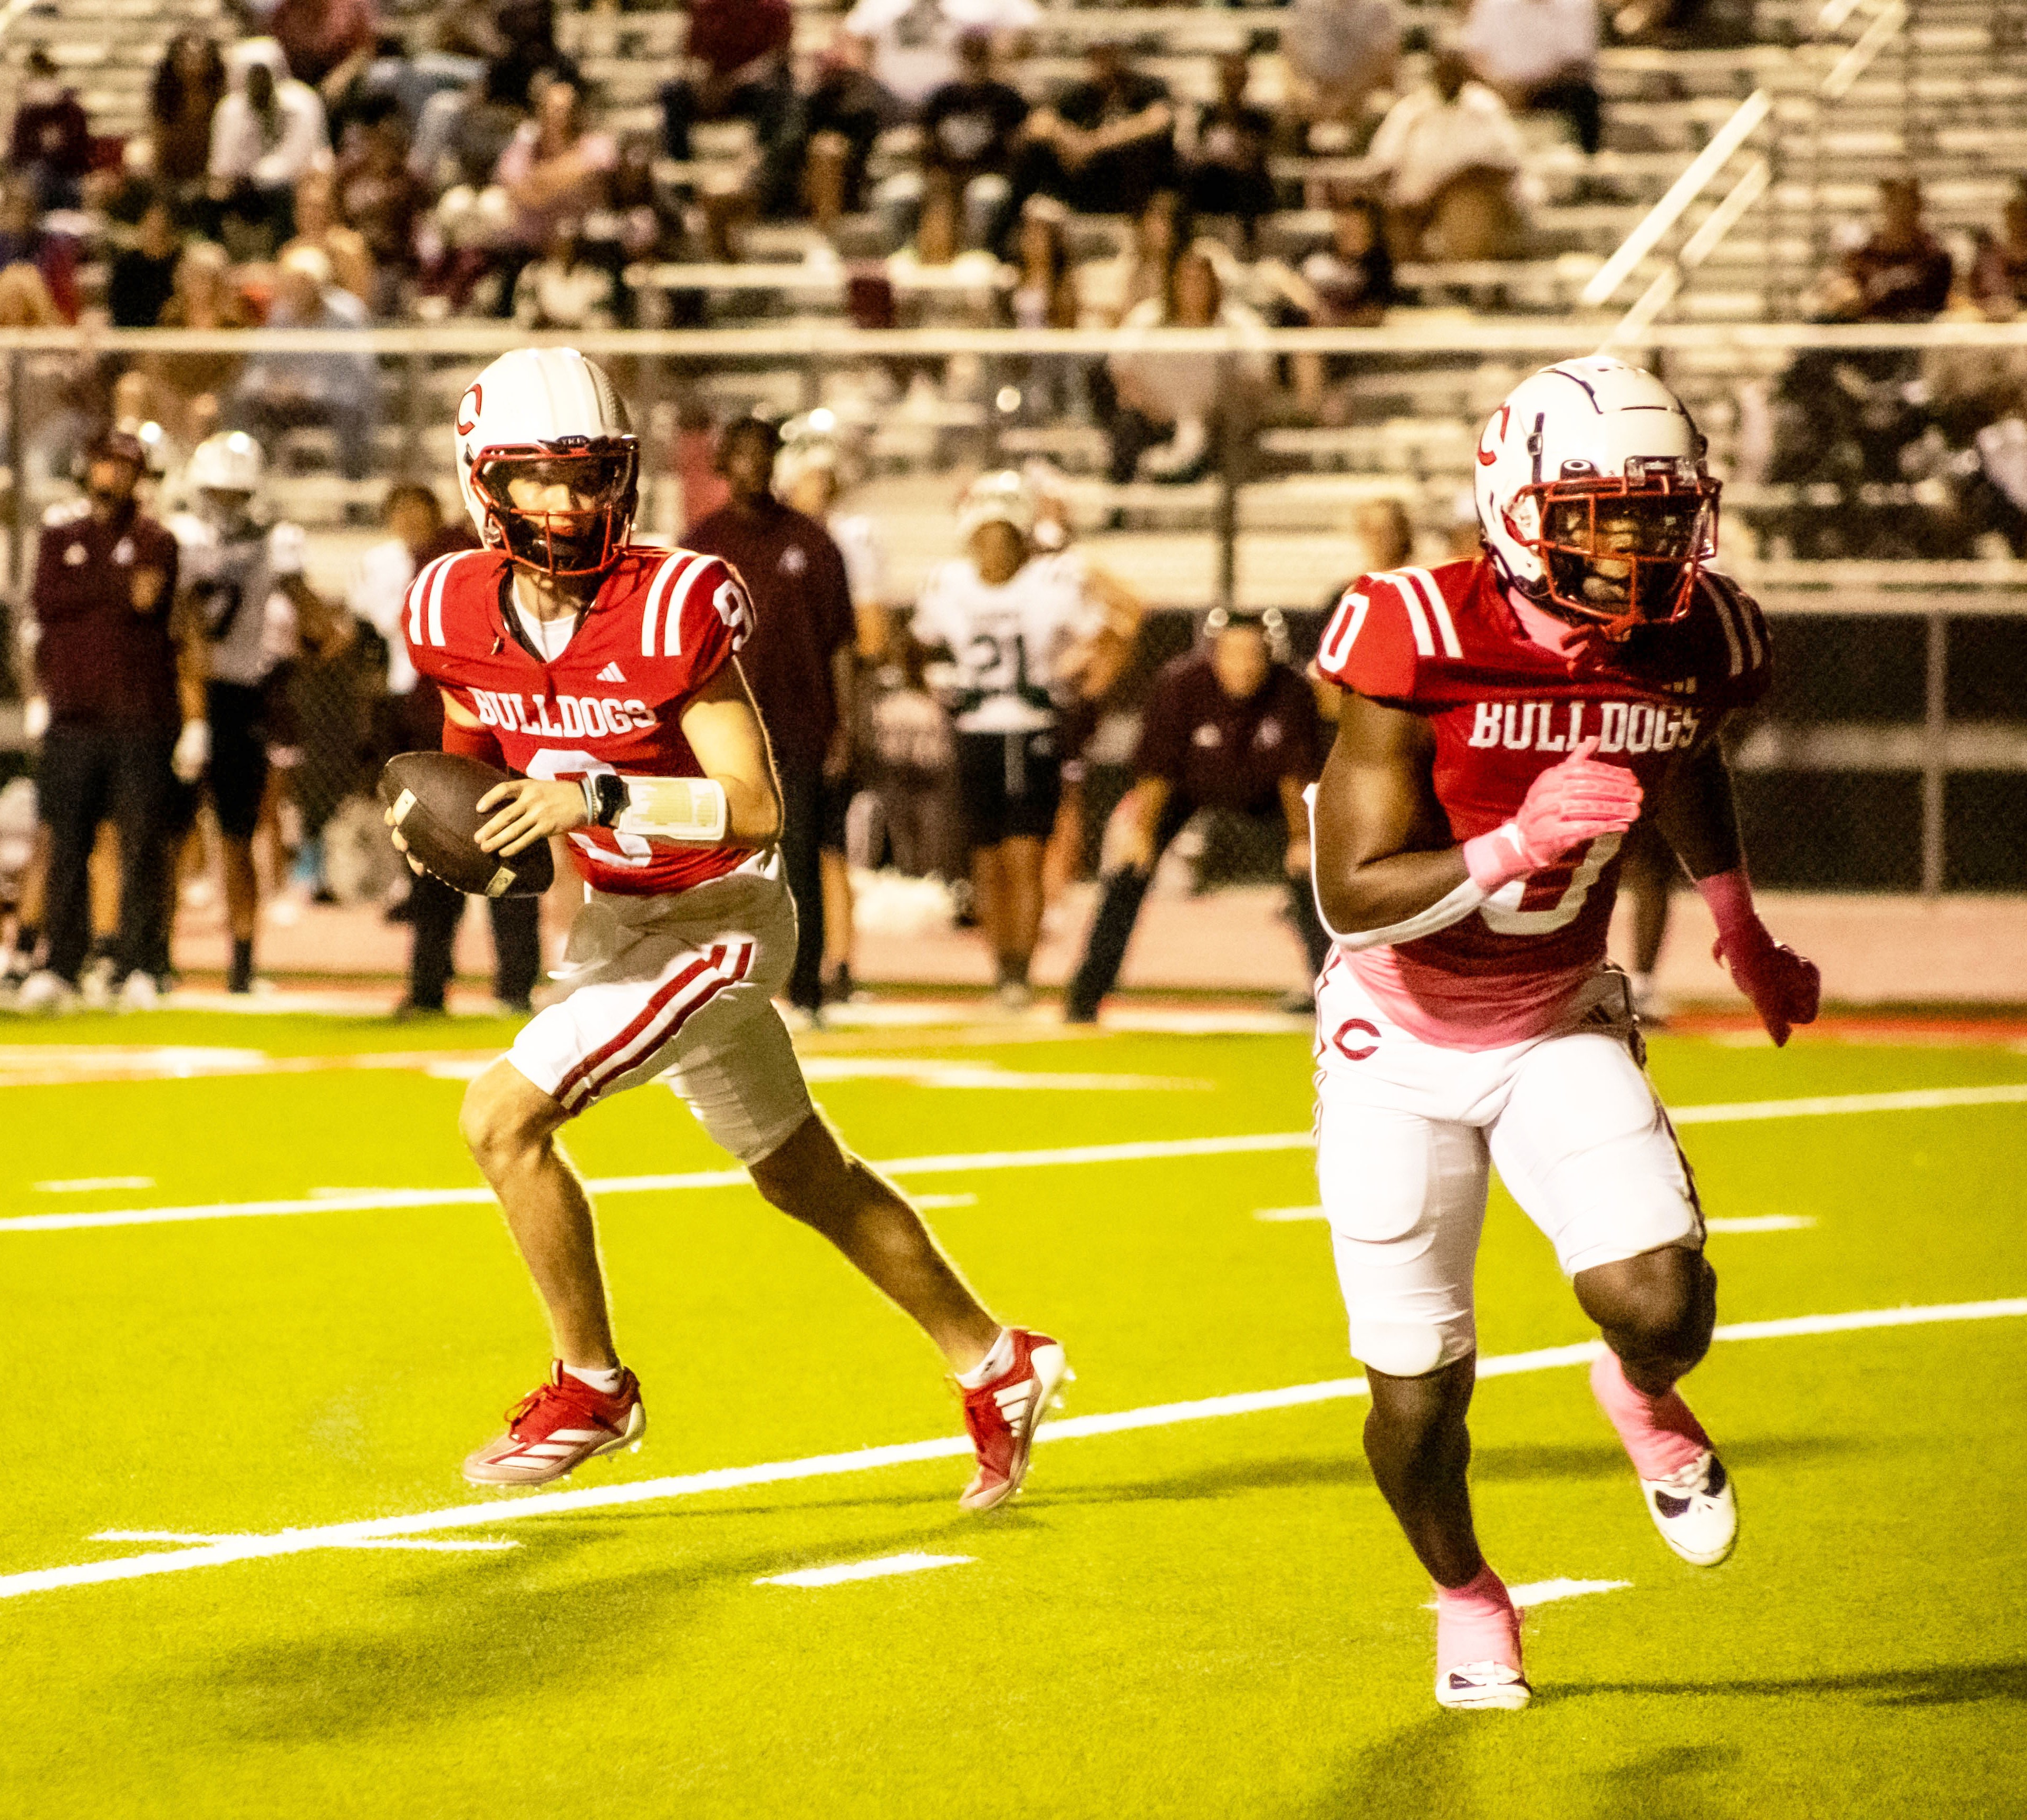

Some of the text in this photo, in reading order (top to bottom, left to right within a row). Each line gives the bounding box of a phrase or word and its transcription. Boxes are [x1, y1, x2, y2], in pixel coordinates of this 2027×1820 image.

[712, 580, 753, 652] 9
[466, 686, 657, 738] BULLDOGS
[1468, 700, 1700, 753] BULLDOGS
